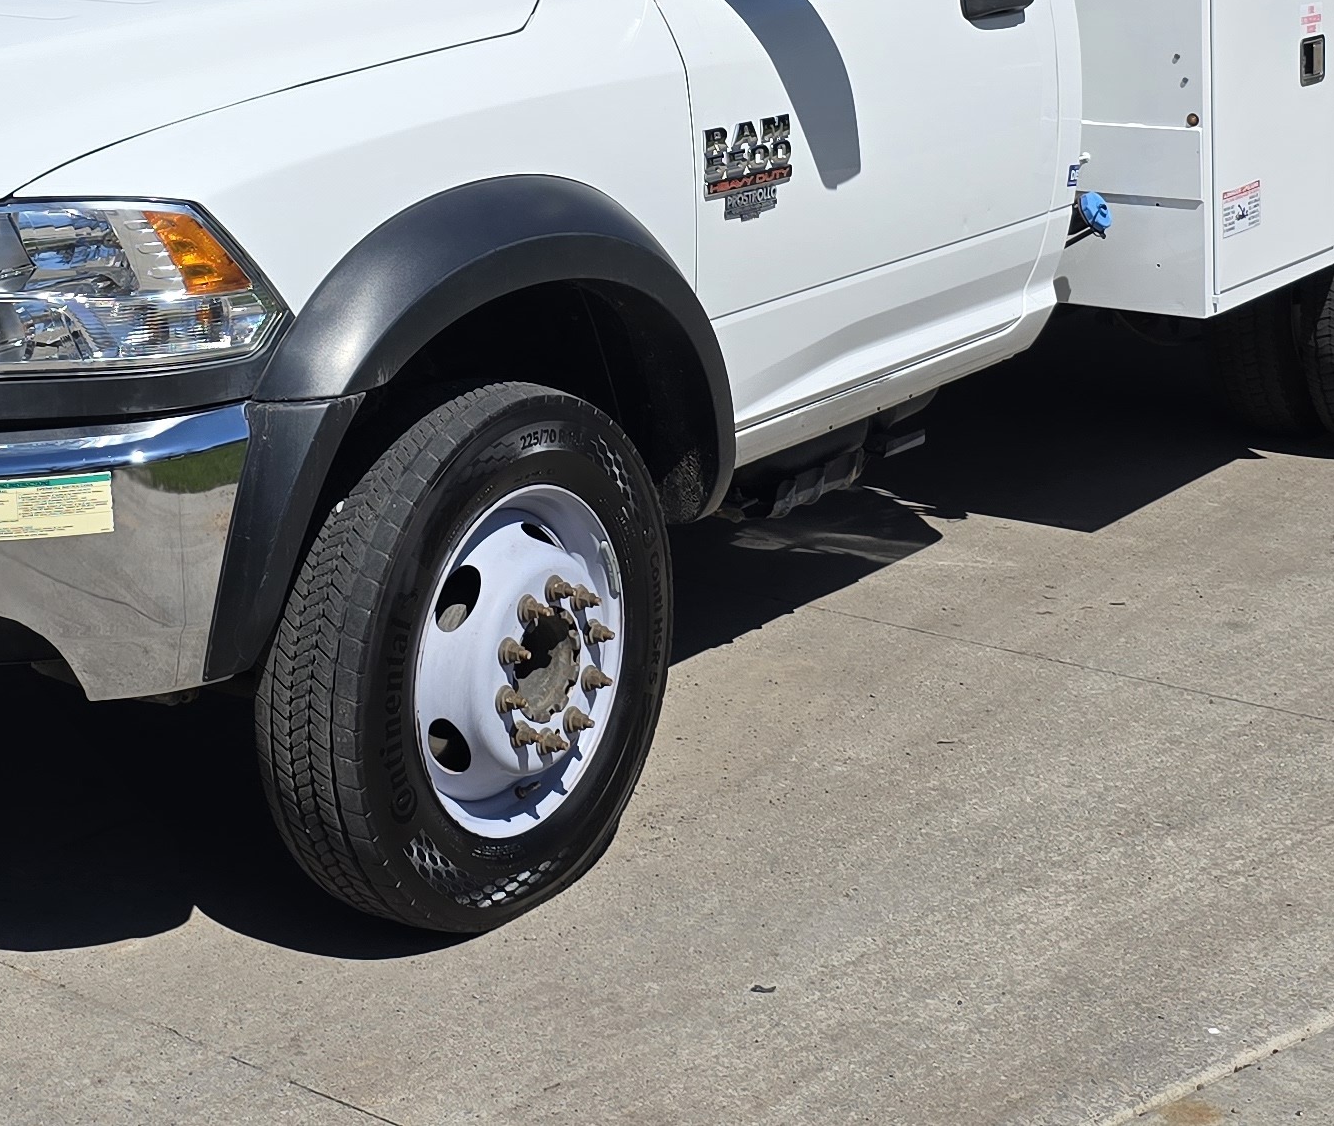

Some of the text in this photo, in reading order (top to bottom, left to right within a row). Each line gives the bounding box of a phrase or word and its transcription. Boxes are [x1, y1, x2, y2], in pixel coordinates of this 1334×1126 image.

[702, 114, 791, 154] RAM
[704, 140, 792, 182] 5500
[709, 167, 790, 194] HEAVY DUTY
[727, 185, 778, 208] PROSTROLLO
[519, 428, 557, 450] 225/70
[380, 615, 417, 821] Continental
